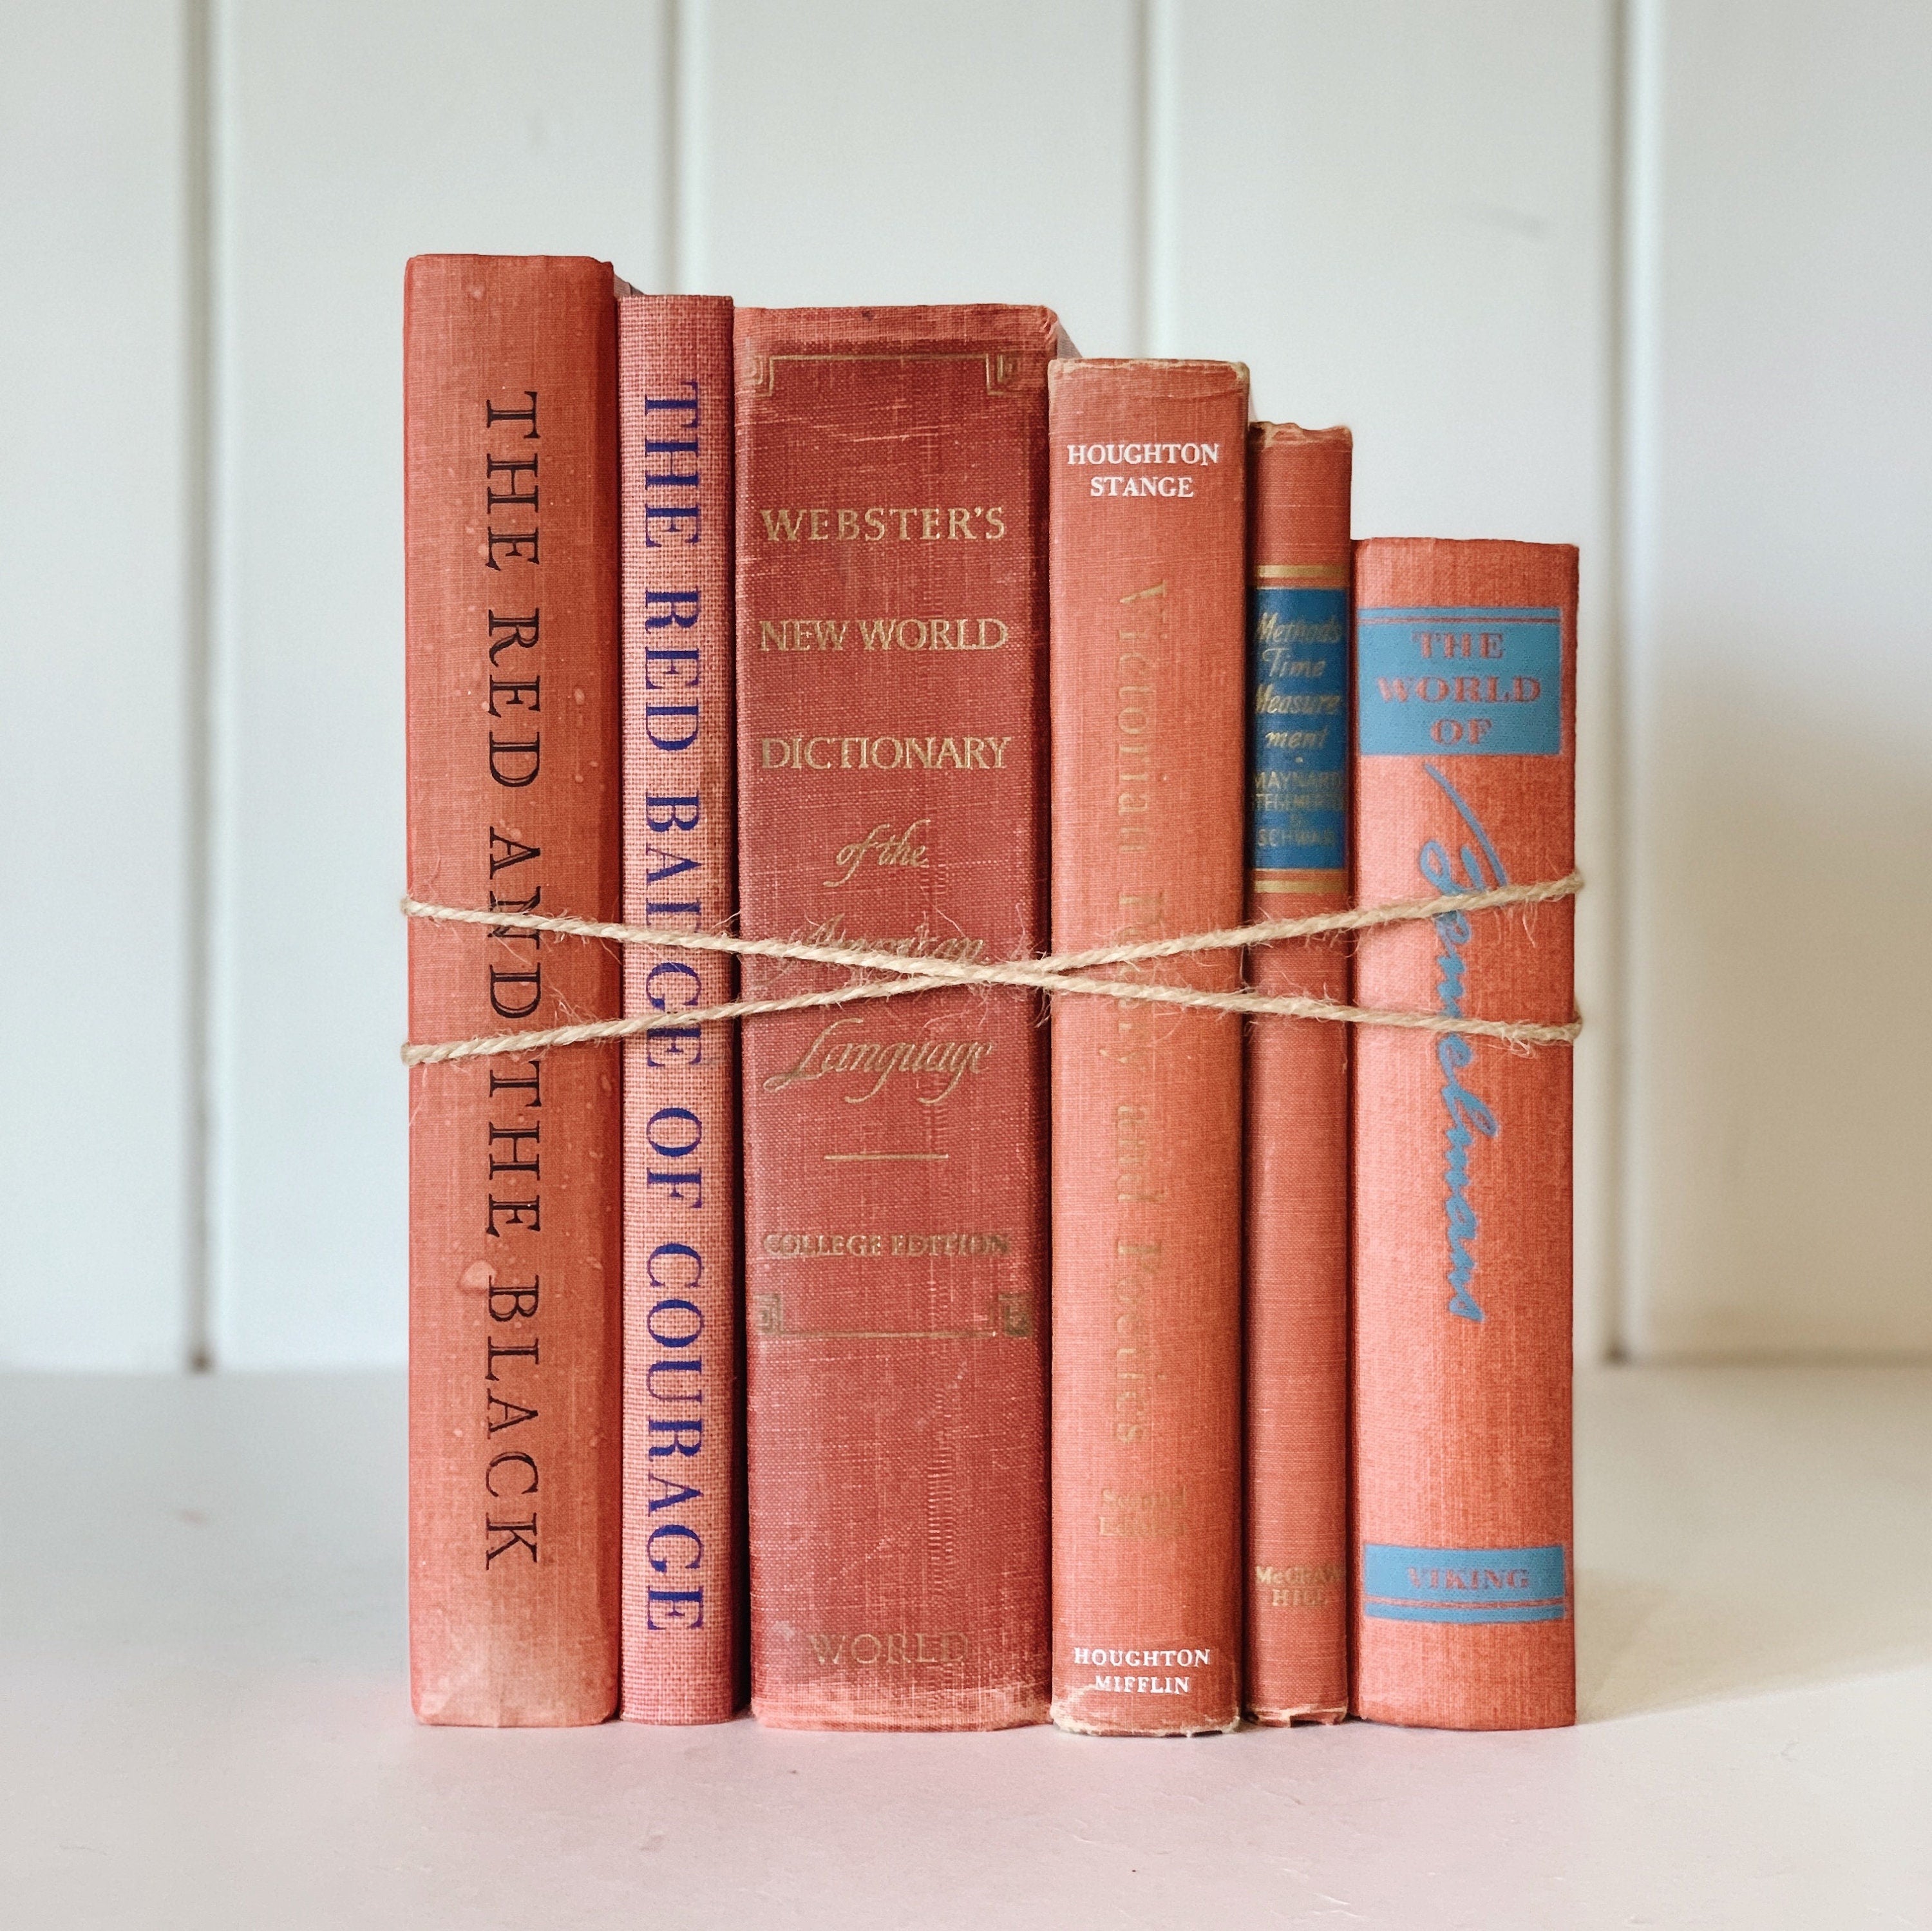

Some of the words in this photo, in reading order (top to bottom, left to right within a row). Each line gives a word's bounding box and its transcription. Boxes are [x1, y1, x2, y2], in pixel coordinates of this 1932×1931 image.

[645, 381, 700, 549] THE
[1066, 442, 1219, 466] HOUGHTON
[486, 390, 539, 572] THE
[1090, 475, 1195, 498] STANGE
[760, 506, 1007, 542] WEBSTER'S
[759, 619, 849, 651] NEW
[858, 618, 1009, 651] WORLD
[1412, 630, 1504, 660] THE
[645, 589, 701, 752] RED
[1262, 647, 1327, 677] Time
[488, 607, 541, 788] RED
[1375, 676, 1542, 703] WORLD
[1117, 578, 1169, 853] Victorian
[1430, 718, 1493, 746] OF
[761, 736, 1011, 770] DICTIONARY
[823, 824, 891, 887] of
[878, 819, 931, 868] the
[487, 825, 542, 1020] AND
[763, 1018, 992, 1104] Language
[485, 1059, 542, 1236] THE
[646, 1106, 703, 1210] OF
[763, 1234, 882, 1257] COLLEGE
[891, 1233, 1010, 1257] EDITION
[485, 1275, 539, 1570] BLACK
[646, 1242, 704, 1631] COURAGE
[1406, 1567, 1530, 1590] VIKING
[1272, 1588, 1328, 1606] HILL
[807, 1631, 969, 1666] WORLD
[1074, 1647, 1211, 1668] HOUGHTON
[1095, 1676, 1190, 1695] MIFFLIN
